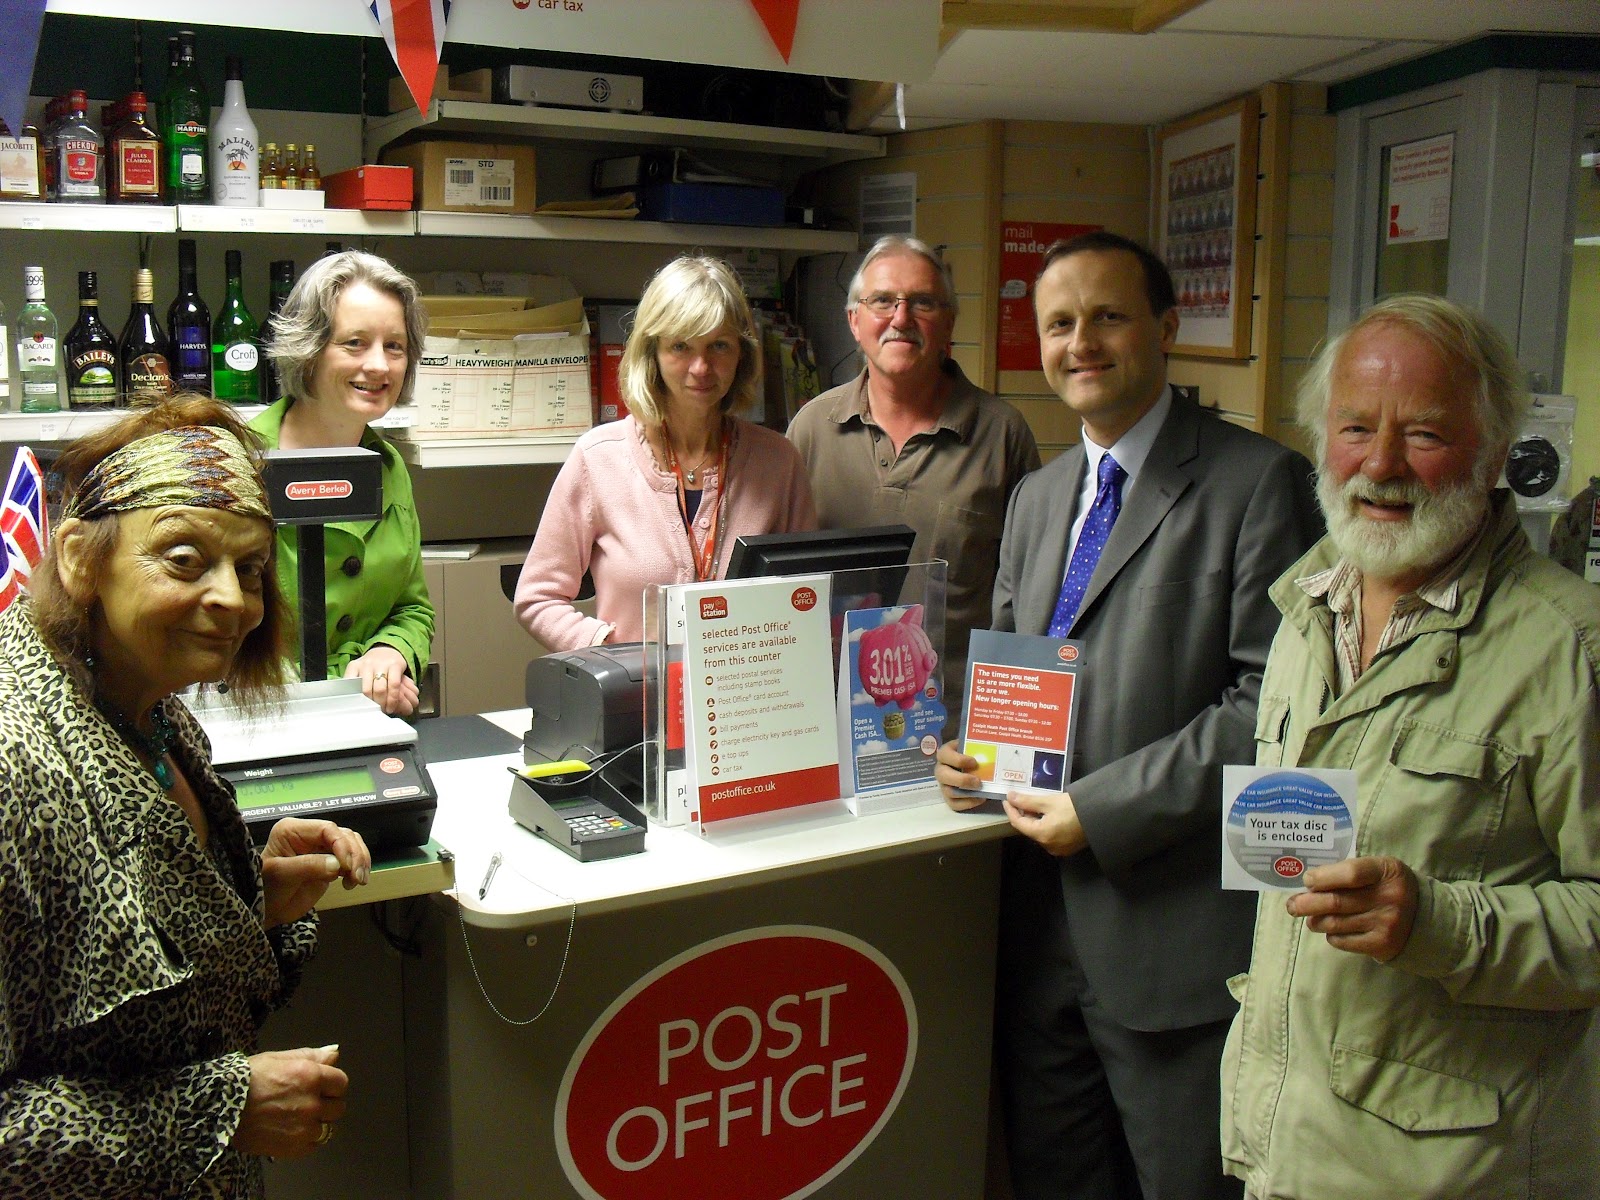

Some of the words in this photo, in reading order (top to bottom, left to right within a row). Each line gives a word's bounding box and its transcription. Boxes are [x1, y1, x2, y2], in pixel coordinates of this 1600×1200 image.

[538, 0, 559, 9] car
[563, 0, 583, 12] tax
[1, 142, 35, 151] JACOBITE
[66, 141, 96, 150] CHEKOV
[218, 136, 255, 152] MALIBU
[478, 160, 494, 168] STD
[1005, 226, 1033, 238] mail
[1004, 241, 1045, 253] made
[76, 351, 115, 367] BAILEYS
[231, 348, 256, 360] Croft
[455, 359, 513, 368] HEAVYWEIGHT
[515, 358, 548, 367] MANILLA
[131, 373, 169, 382] Declan's
[290, 486, 316, 496] Avery
[319, 484, 348, 494] Berkel
[703, 603, 714, 611] pay
[793, 597, 814, 606] OFFICE
[702, 609, 726, 617] station
[702, 627, 738, 639] selected
[742, 625, 761, 635] Post
[703, 642, 738, 654] services
[742, 641, 756, 650] are
[759, 636, 797, 648] available
[704, 658, 726, 668] from
[729, 655, 745, 666] this
[748, 652, 781, 663] counter
[716, 672, 740, 682] selected
[741, 670, 759, 679] postal
[760, 667, 783, 676] services
[977, 669, 990, 677] The
[991, 670, 1009, 679] times
[1010, 673, 1022, 681] you
[717, 680, 743, 692] including
[745, 679, 763, 690] stamp
[764, 677, 781, 687] books
[1016, 681, 1041, 691] flexible.
[718, 696, 731, 705] Post
[753, 691, 766, 701] card
[767, 689, 789, 699] account
[975, 694, 989, 702] New
[991, 696, 1011, 706] longer
[1012, 700, 1038, 709] opening
[1039, 702, 1059, 711] hours:
[719, 709, 732, 719] cash
[734, 707, 758, 718] deposits
[759, 704, 770, 713] and
[771, 700, 804, 712] withdrawals
[854, 718, 868, 726] Open
[914, 717, 926, 725] your
[926, 715, 944, 724] savings
[720, 724, 728, 733] bill
[730, 721, 758, 732] payments
[721, 737, 740, 748] charge
[742, 733, 769, 744] electricity
[770, 731, 780, 740] key
[781, 729, 792, 737] and
[793, 728, 803, 737] gas
[804, 725, 819, 734] cards
[727, 751, 737, 760] top
[738, 750, 749, 759] ups
[244, 769, 273, 777] Weight
[733, 764, 743, 772] tax
[711, 780, 776, 802] postoffice.co.uk
[1257, 787, 1281, 795] INSURANCE
[1299, 787, 1313, 795] VALUE
[278, 801, 322, 812] VALUABLE?
[354, 795, 377, 803] KNOW
[1257, 799, 1281, 808] INSURANCE
[1299, 800, 1313, 808] VALUE
[1250, 818, 1277, 829] Your
[1281, 820, 1300, 830] tax
[1304, 820, 1327, 831] disc
[1257, 831, 1267, 841] is
[1271, 832, 1323, 843] enclosed
[658, 983, 848, 1087] POST
[606, 1053, 867, 1172] OFFICE
